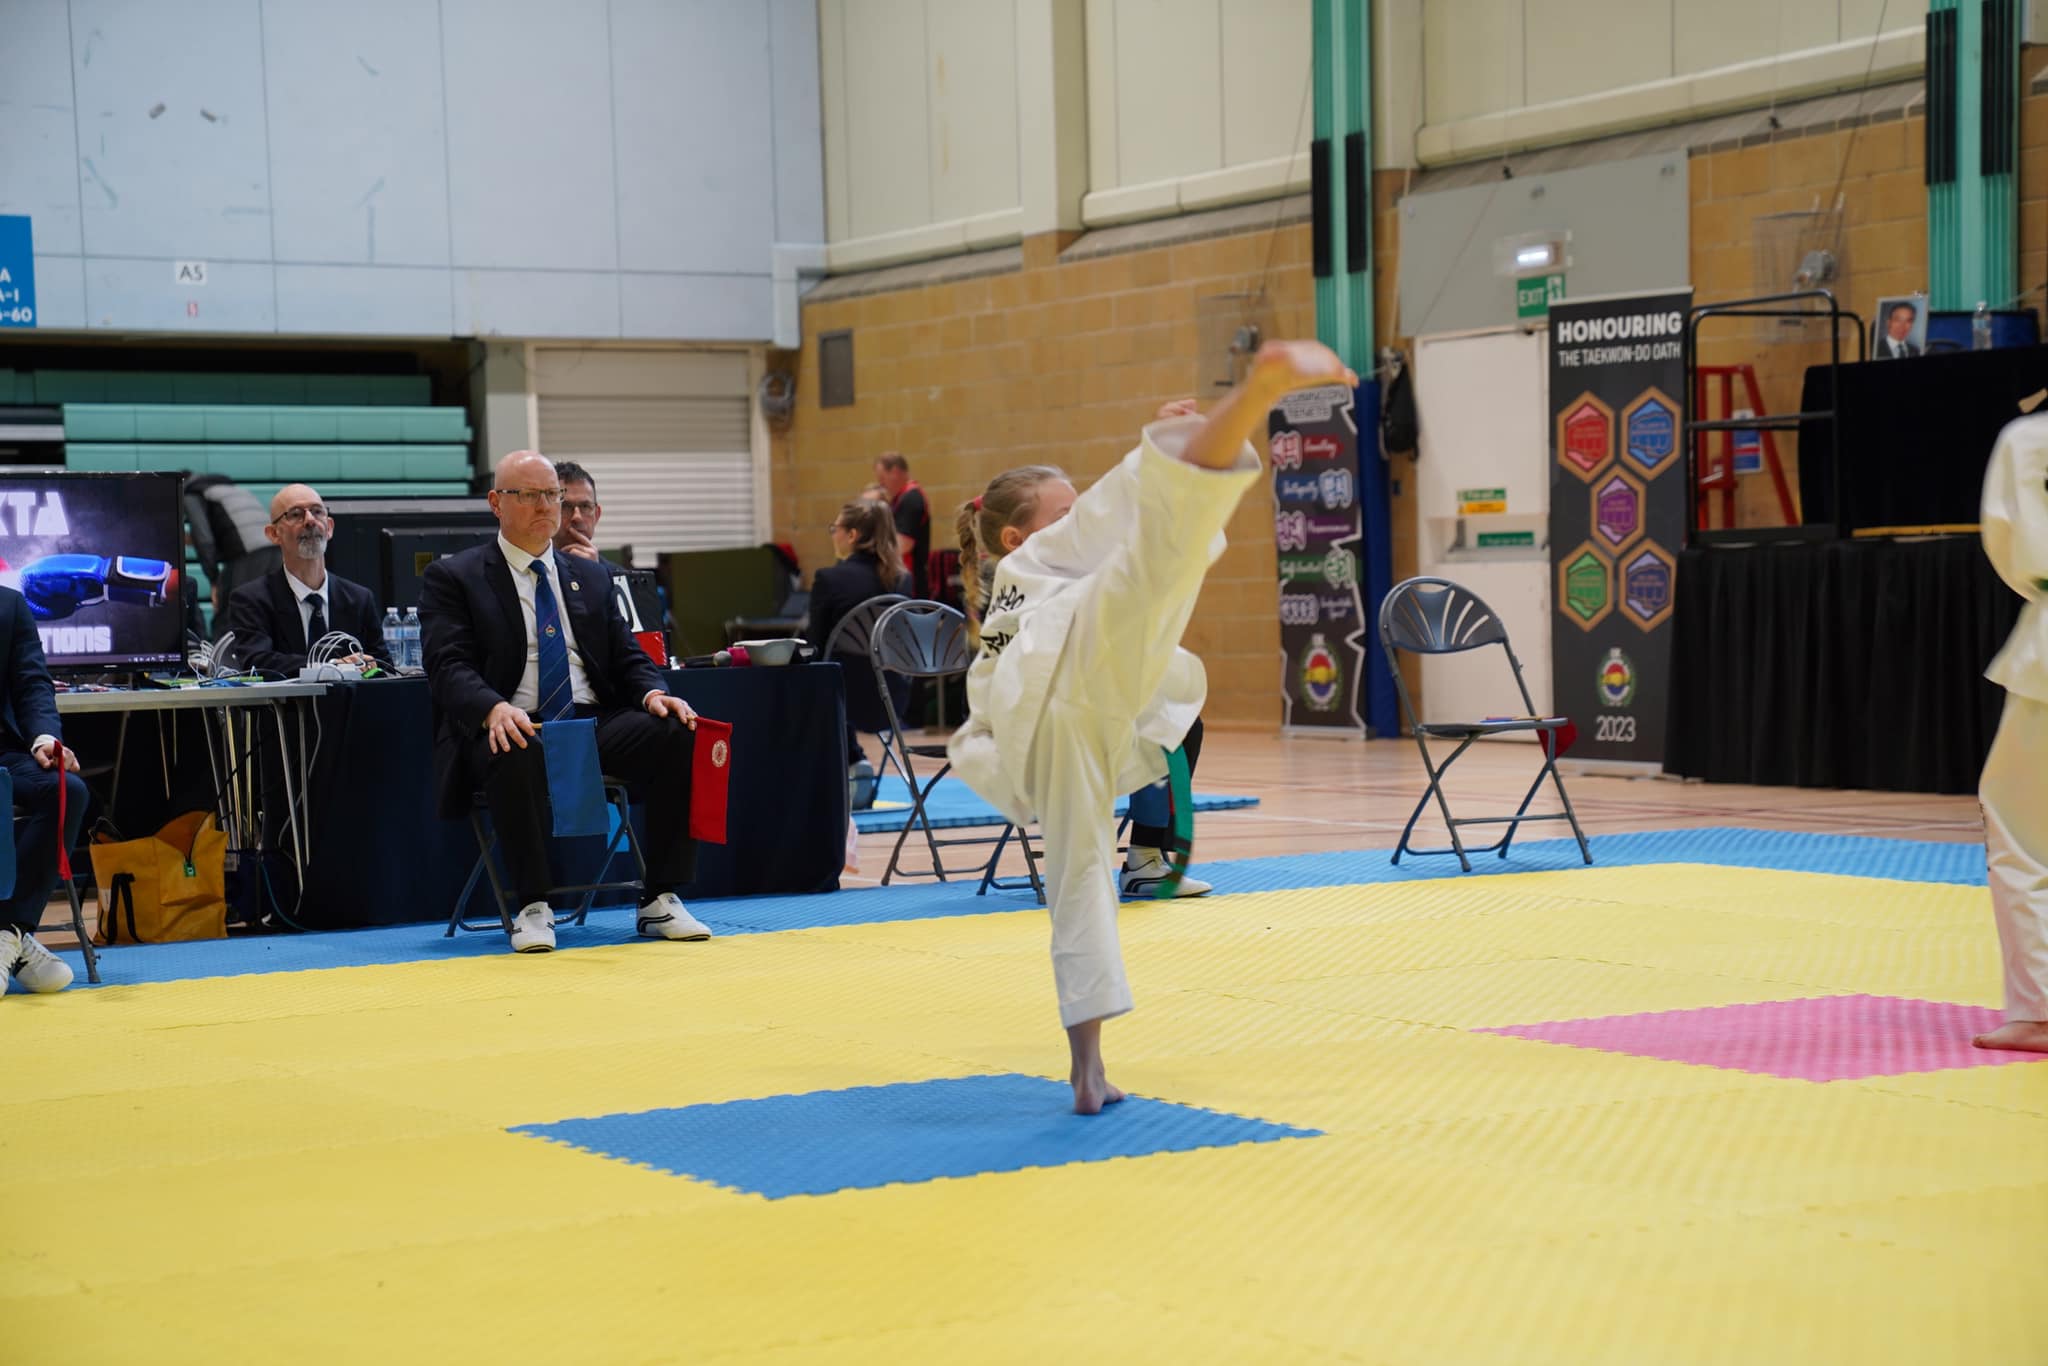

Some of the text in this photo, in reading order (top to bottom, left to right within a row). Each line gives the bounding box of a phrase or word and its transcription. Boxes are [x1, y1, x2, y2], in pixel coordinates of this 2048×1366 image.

[1519, 288, 1545, 307] EXIT
[0, 307, 32, 323] -60
[1558, 312, 1683, 344] HONOURING
[1559, 342, 1681, 367] THE TAEKWON-DO OATH
[0, 491, 70, 536] TA
[1596, 715, 1637, 743] 2023
